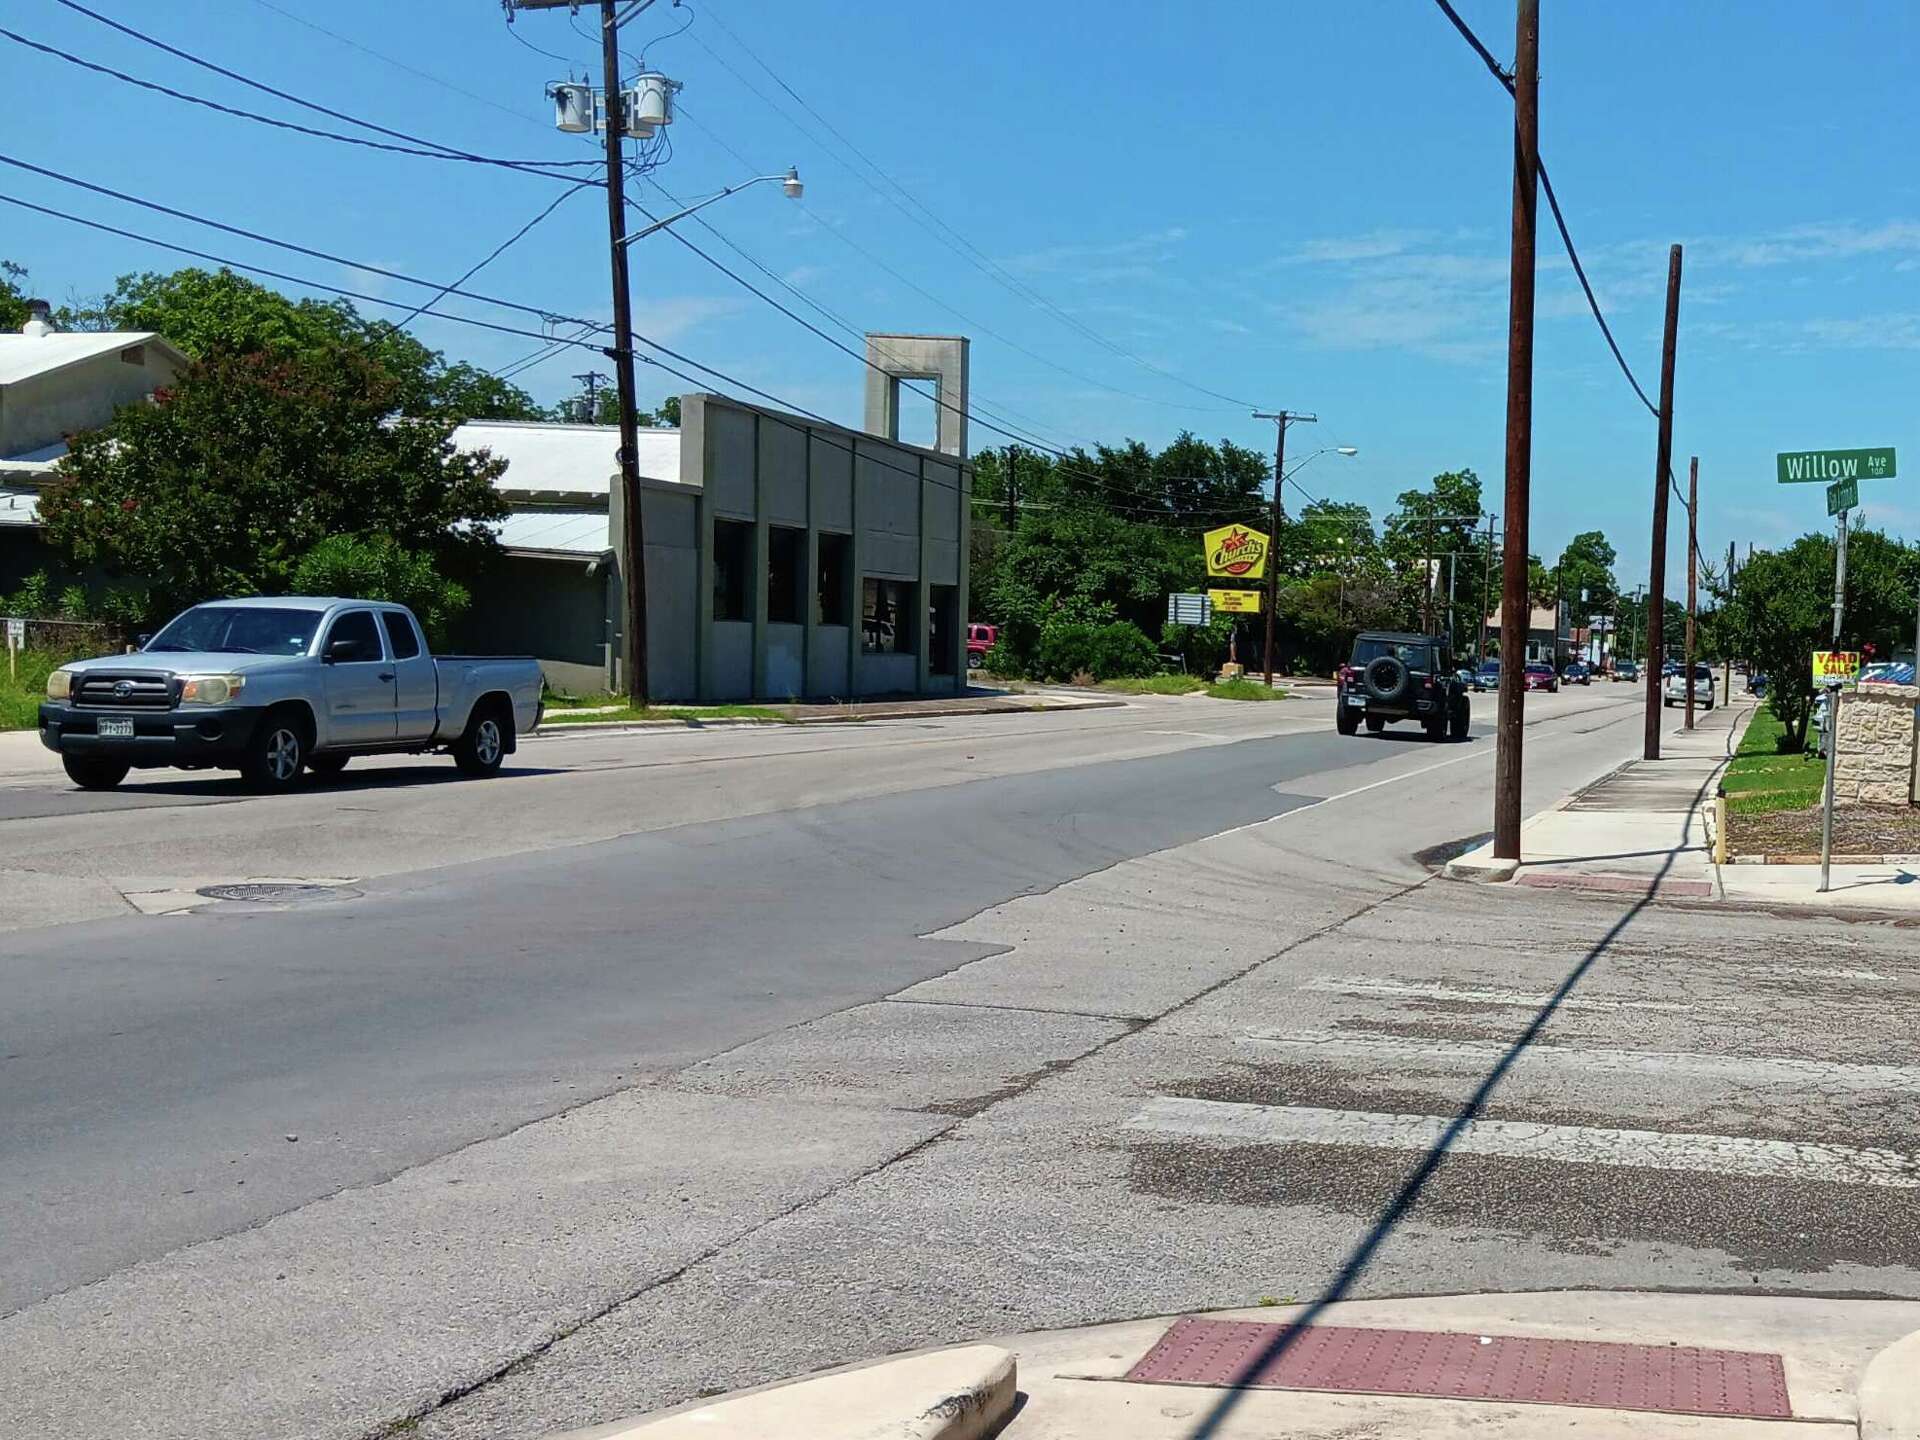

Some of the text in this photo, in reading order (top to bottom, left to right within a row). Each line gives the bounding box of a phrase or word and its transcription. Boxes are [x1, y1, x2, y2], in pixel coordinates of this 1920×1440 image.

[1787, 455, 1887, 479] Willow Ave
[1211, 540, 1263, 569] Church's
[1816, 653, 1857, 664] YARD
[1824, 663, 1851, 674] SALE
